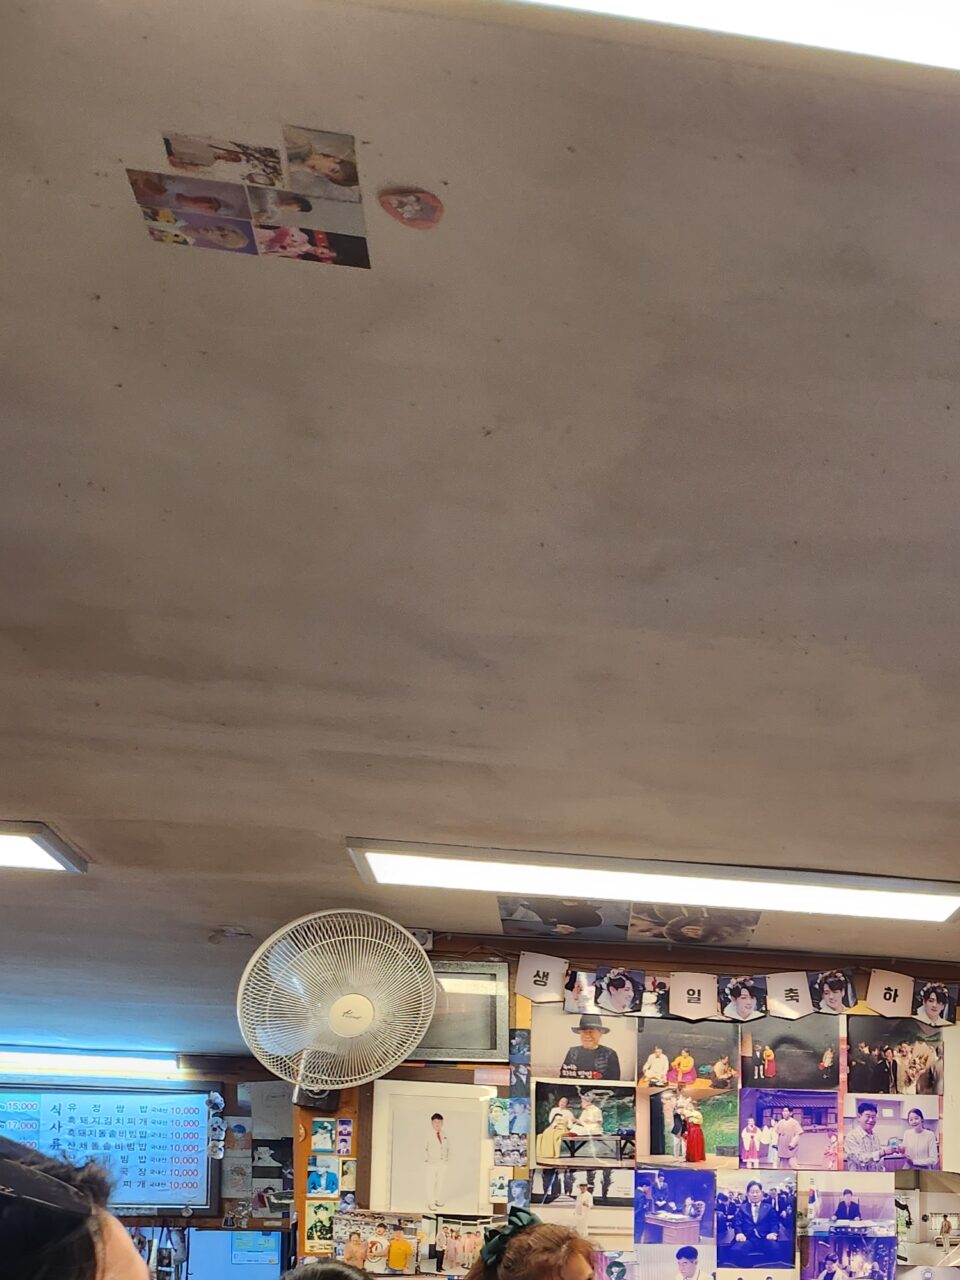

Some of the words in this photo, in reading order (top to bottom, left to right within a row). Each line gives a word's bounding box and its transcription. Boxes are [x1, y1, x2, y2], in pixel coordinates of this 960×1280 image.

[533, 969, 549, 987] 생
[686, 988, 702, 1004] 일
[784, 987, 799, 1003] 축
[883, 986, 899, 1002] 하
[8, 1102, 38, 1111] 15,000
[170, 1107, 200, 1115] 10,000
[6, 1121, 37, 1130] 17,000
[170, 1119, 200, 1127] 10,000
[170, 1131, 200, 1140] 10,000
[170, 1144, 200, 1152] 10,000
[169, 1156, 199, 1165] 10,000
[169, 1168, 199, 1177] 10,000
[169, 1181, 198, 1189] 10,000
